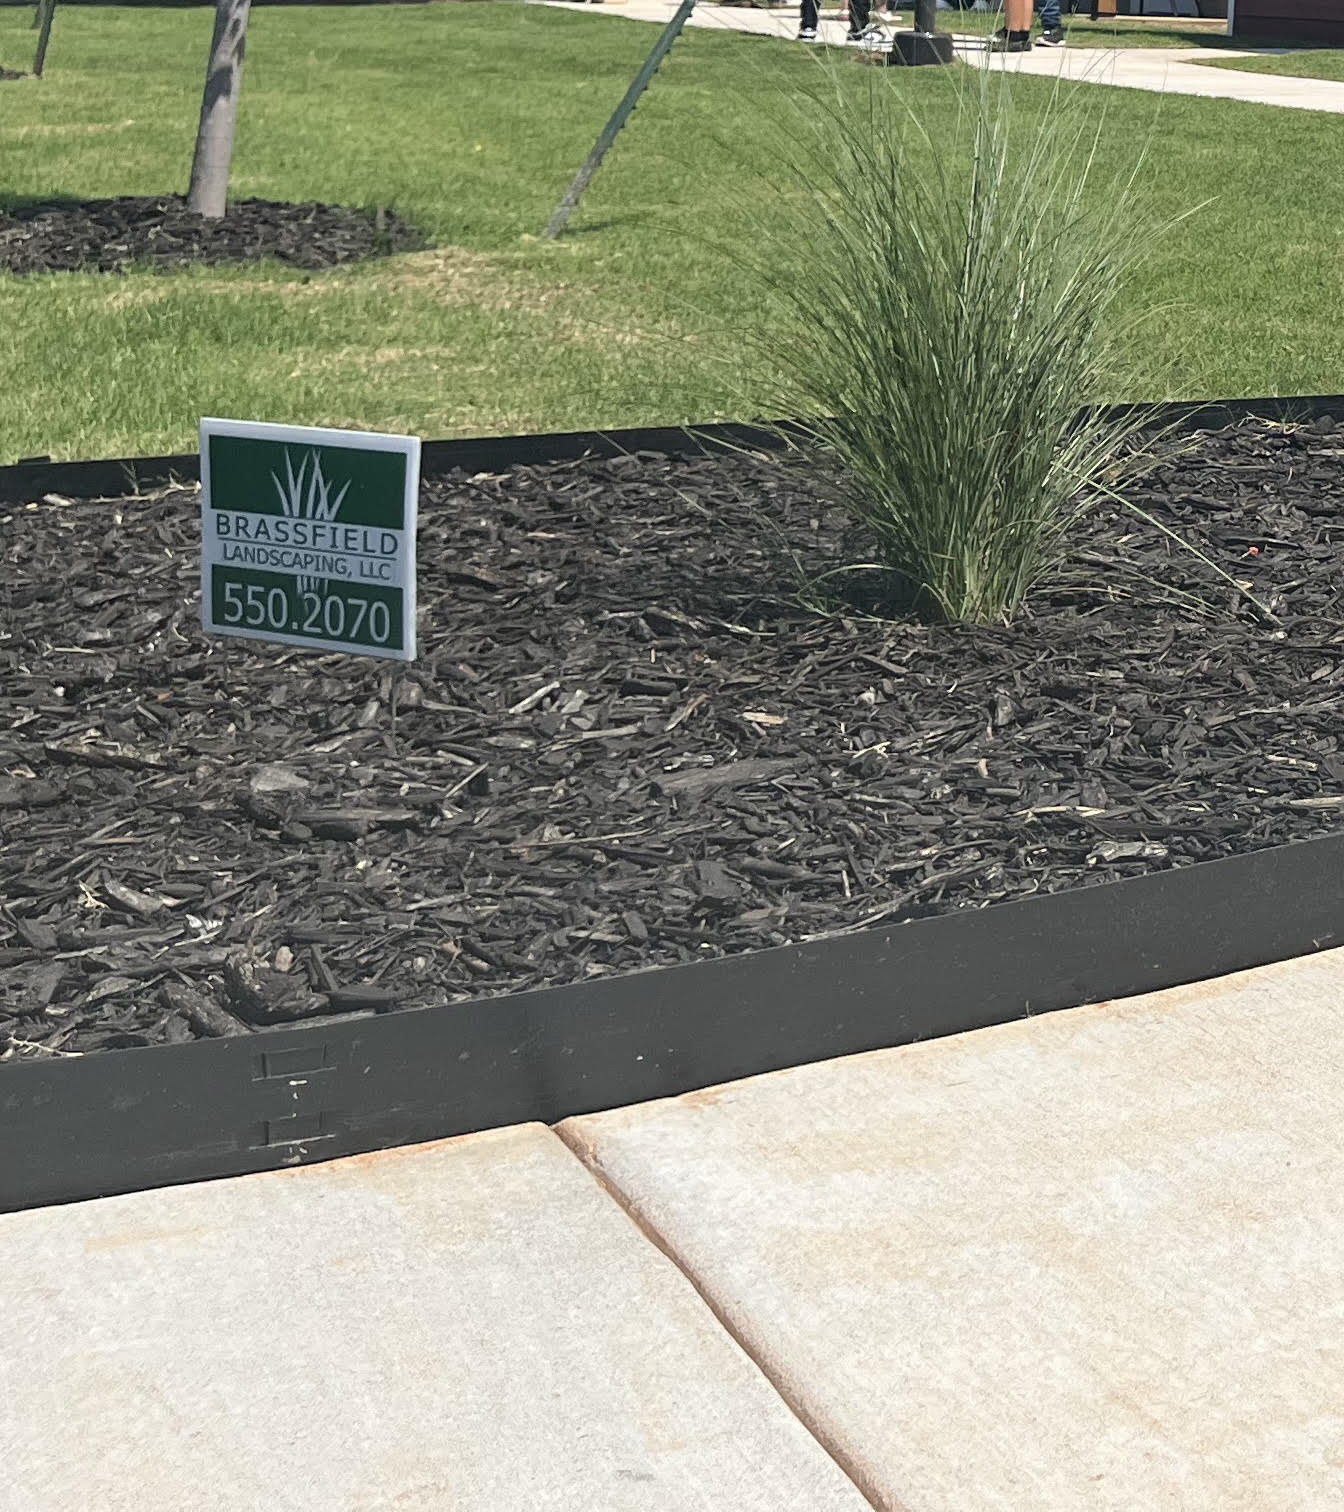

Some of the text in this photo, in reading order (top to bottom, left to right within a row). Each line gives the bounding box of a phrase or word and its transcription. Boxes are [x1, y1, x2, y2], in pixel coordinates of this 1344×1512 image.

[216, 513, 399, 555] BRASSFIELD
[223, 543, 392, 581] LANDSCAPING, LLC
[223, 581, 391, 643] 550.2070
